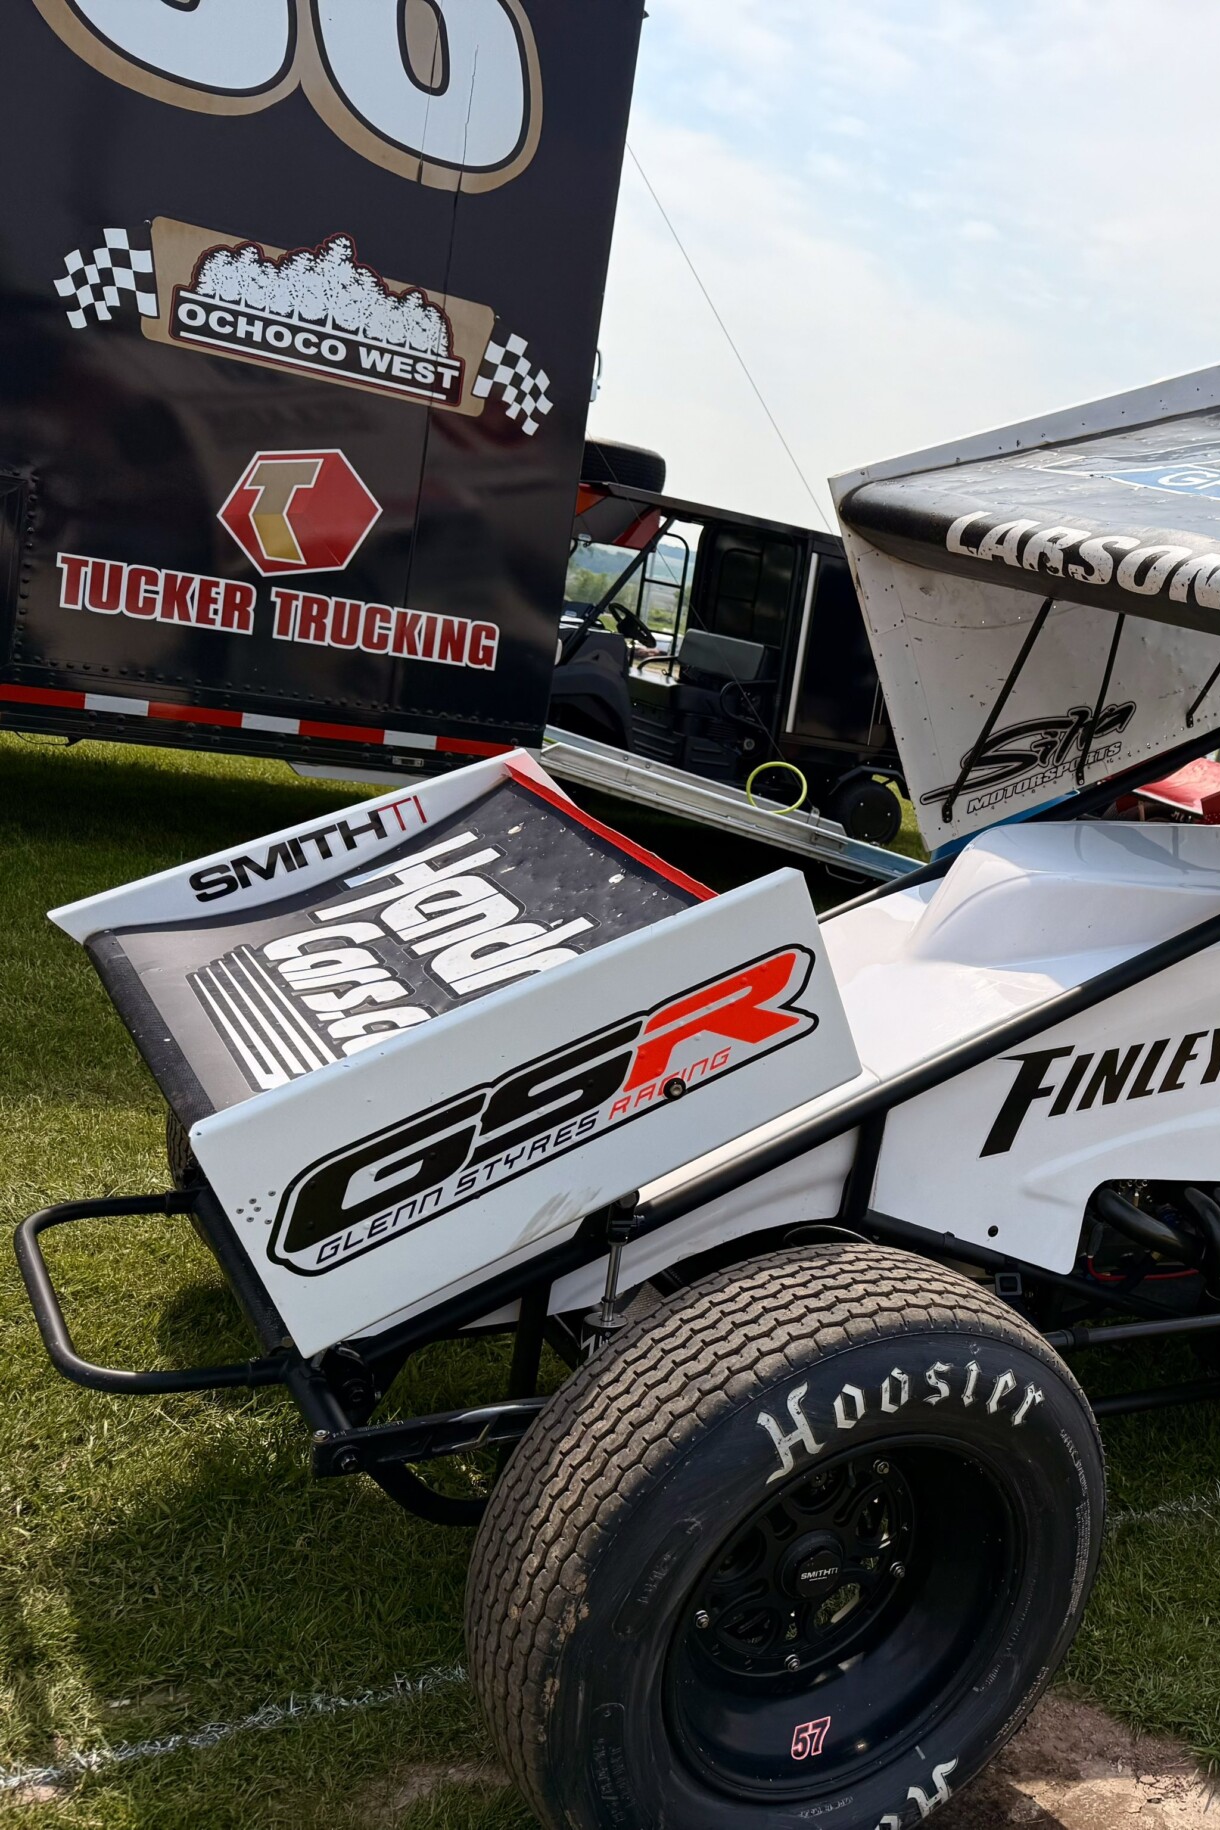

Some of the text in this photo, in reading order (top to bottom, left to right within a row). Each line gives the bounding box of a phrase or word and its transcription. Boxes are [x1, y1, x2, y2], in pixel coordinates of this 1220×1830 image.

[177, 303, 461, 390] OCHOCO WEST
[56, 551, 500, 671] TUCKER TRUCKING
[284, 952, 800, 1253] GSR
[316, 1046, 732, 1266] GLENN STYRES RACING
[756, 1358, 1046, 1485] Hoosier
[790, 1715, 832, 1761] 57
